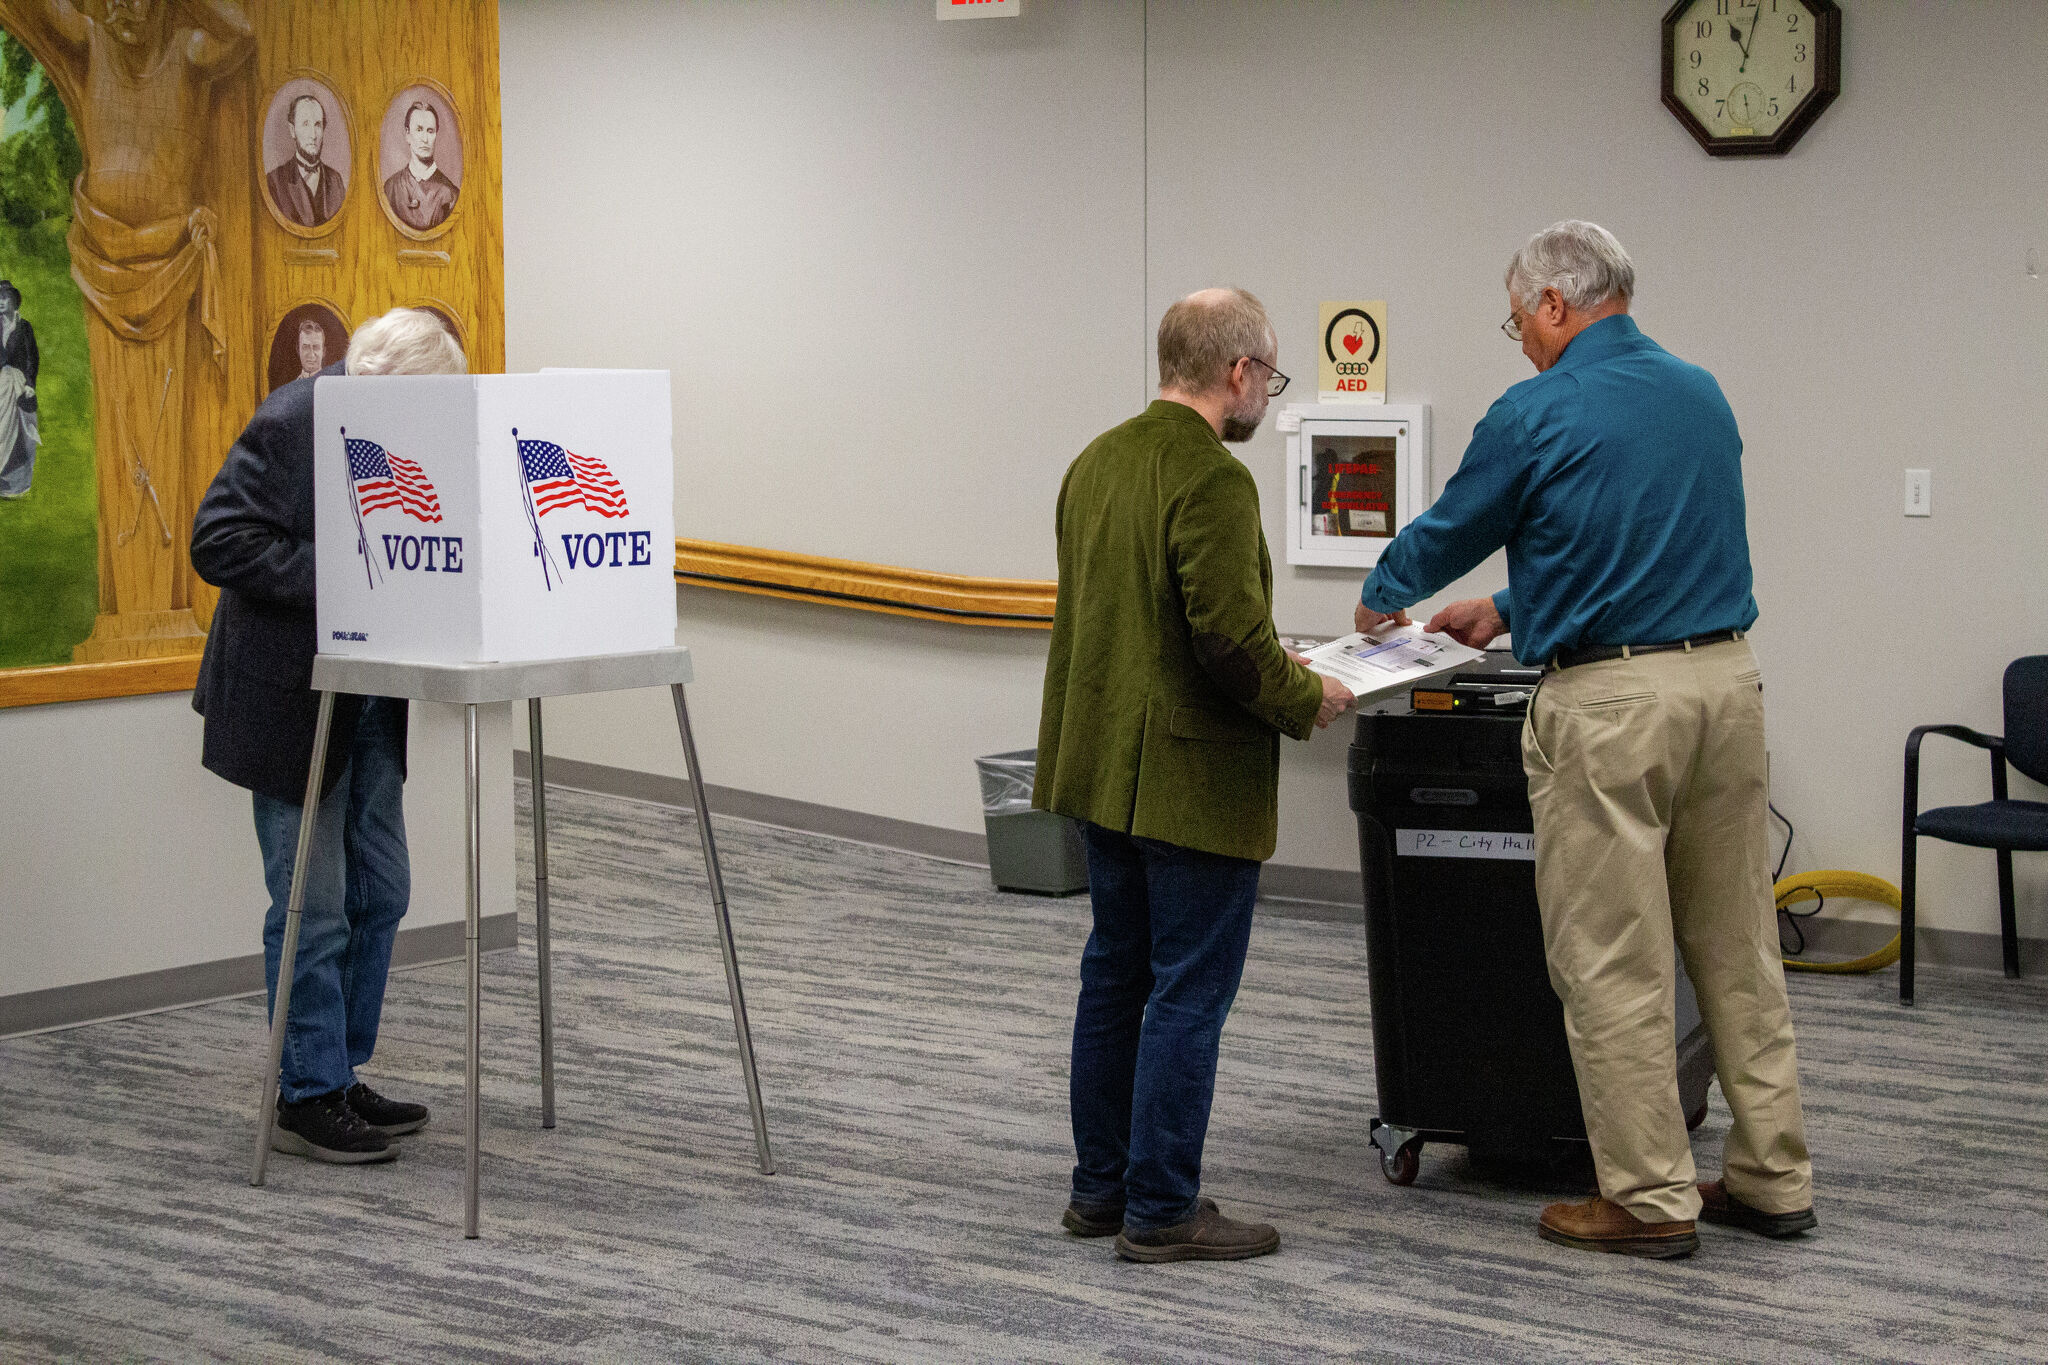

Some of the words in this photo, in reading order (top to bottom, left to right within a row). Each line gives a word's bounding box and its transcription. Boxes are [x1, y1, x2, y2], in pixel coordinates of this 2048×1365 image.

[1696, 20, 1712, 38] 10
[1787, 13, 1799, 33] 2
[1690, 49, 1702, 69] 9
[1794, 43, 1806, 63] 3
[1698, 77, 1710, 97] 8
[1785, 74, 1797, 93] 4
[1715, 99, 1726, 118] 7
[1767, 97, 1779, 117] 5
[1336, 379, 1368, 392] AED
[382, 534, 463, 573] VOTE
[561, 530, 652, 569] VOTE
[1459, 836, 1493, 851] City
